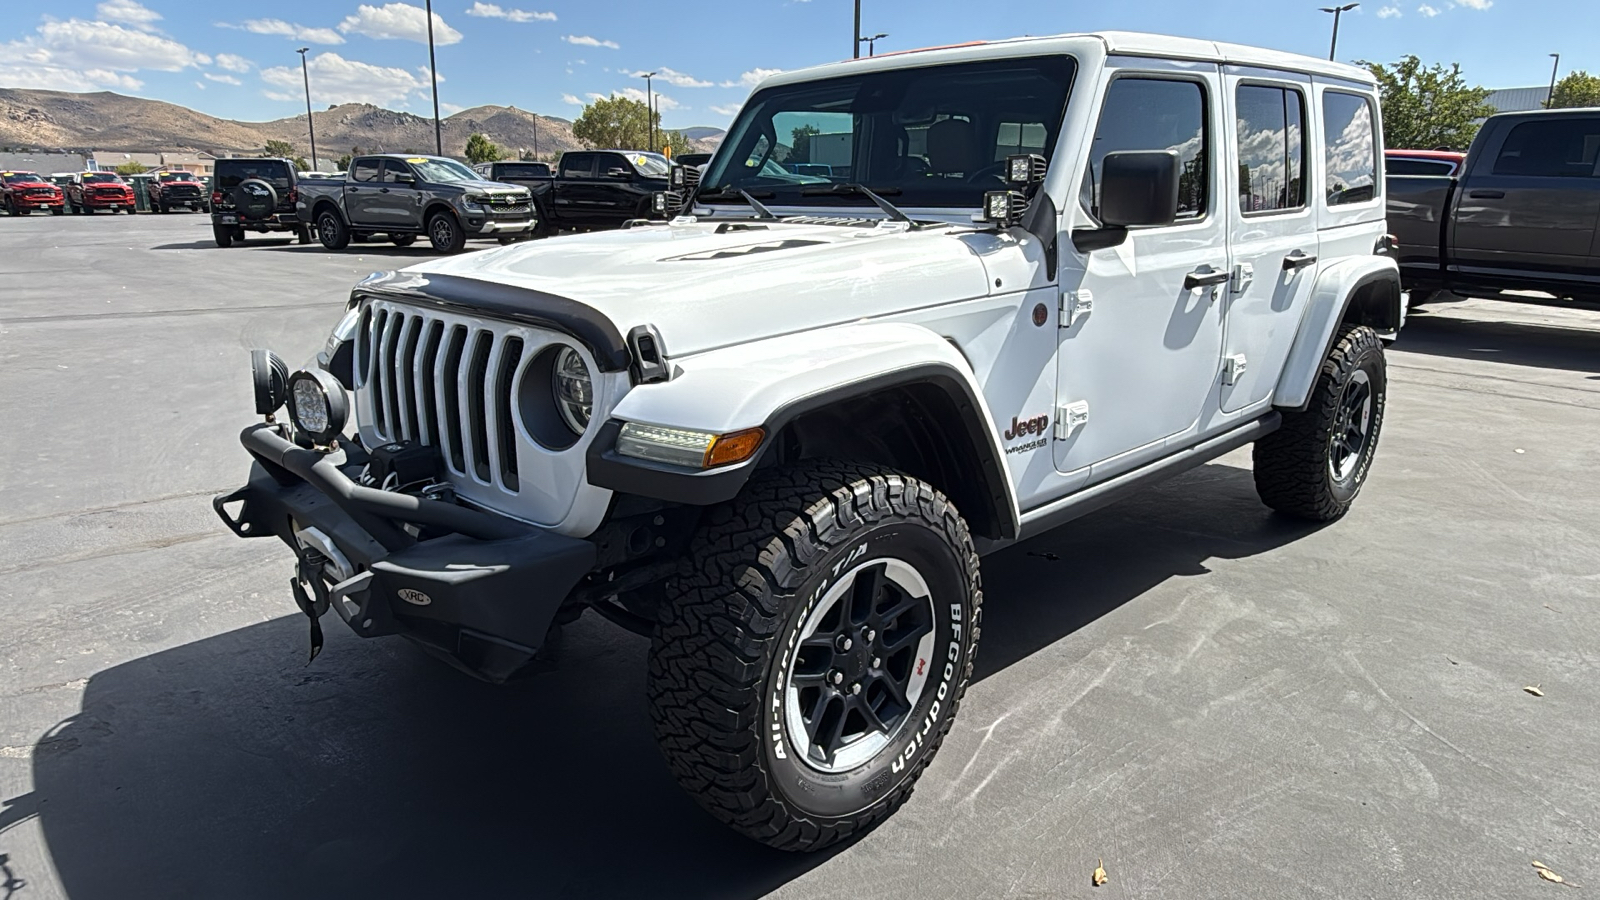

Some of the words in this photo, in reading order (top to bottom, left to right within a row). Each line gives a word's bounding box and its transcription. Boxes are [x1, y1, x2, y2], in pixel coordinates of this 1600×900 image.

[1004, 414, 1049, 440] Jeep
[1005, 437, 1047, 454] WRANGLER
[832, 542, 868, 577] T/A
[403, 589, 425, 602] XRC
[891, 603, 962, 773] BFGoodrich
